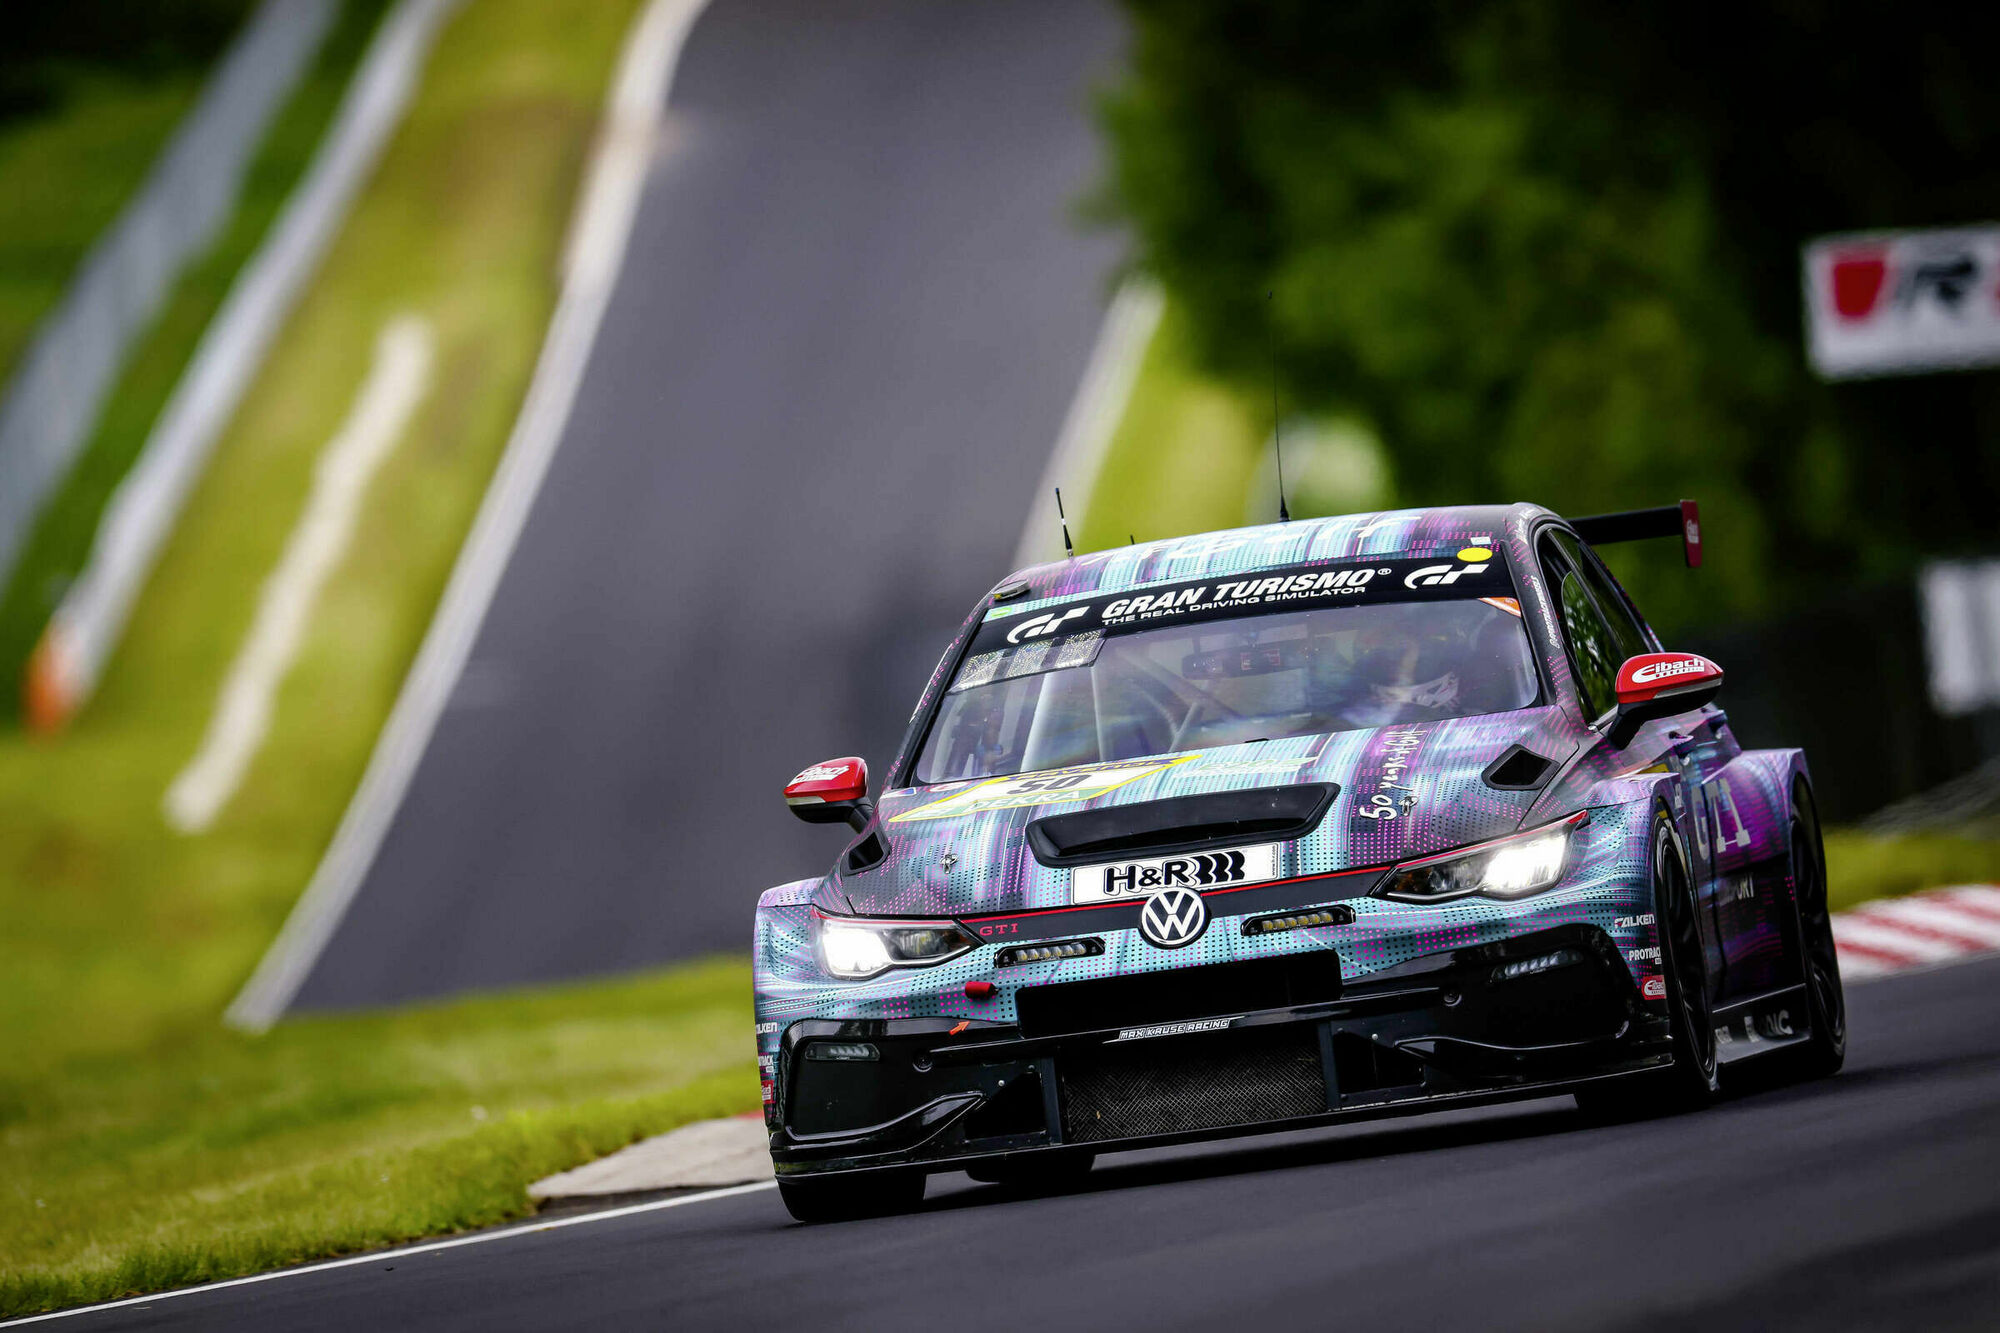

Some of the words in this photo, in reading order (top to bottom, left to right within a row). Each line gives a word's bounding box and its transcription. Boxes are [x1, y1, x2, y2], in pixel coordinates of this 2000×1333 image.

[1102, 586, 1207, 619] GRAN
[1102, 614, 1136, 626] THE
[1140, 607, 1185, 620] REAL
[1189, 596, 1261, 612] DRIVING
[1264, 586, 1366, 602] SIMULATOR
[1631, 658, 1705, 683] Eibach
[1007, 774, 1092, 795] 50
[1359, 794, 1398, 820] 50
[979, 923, 1019, 936] GTI
[1614, 913, 1655, 929] FALKEN
[1186, 1018, 1230, 1034] RACING
